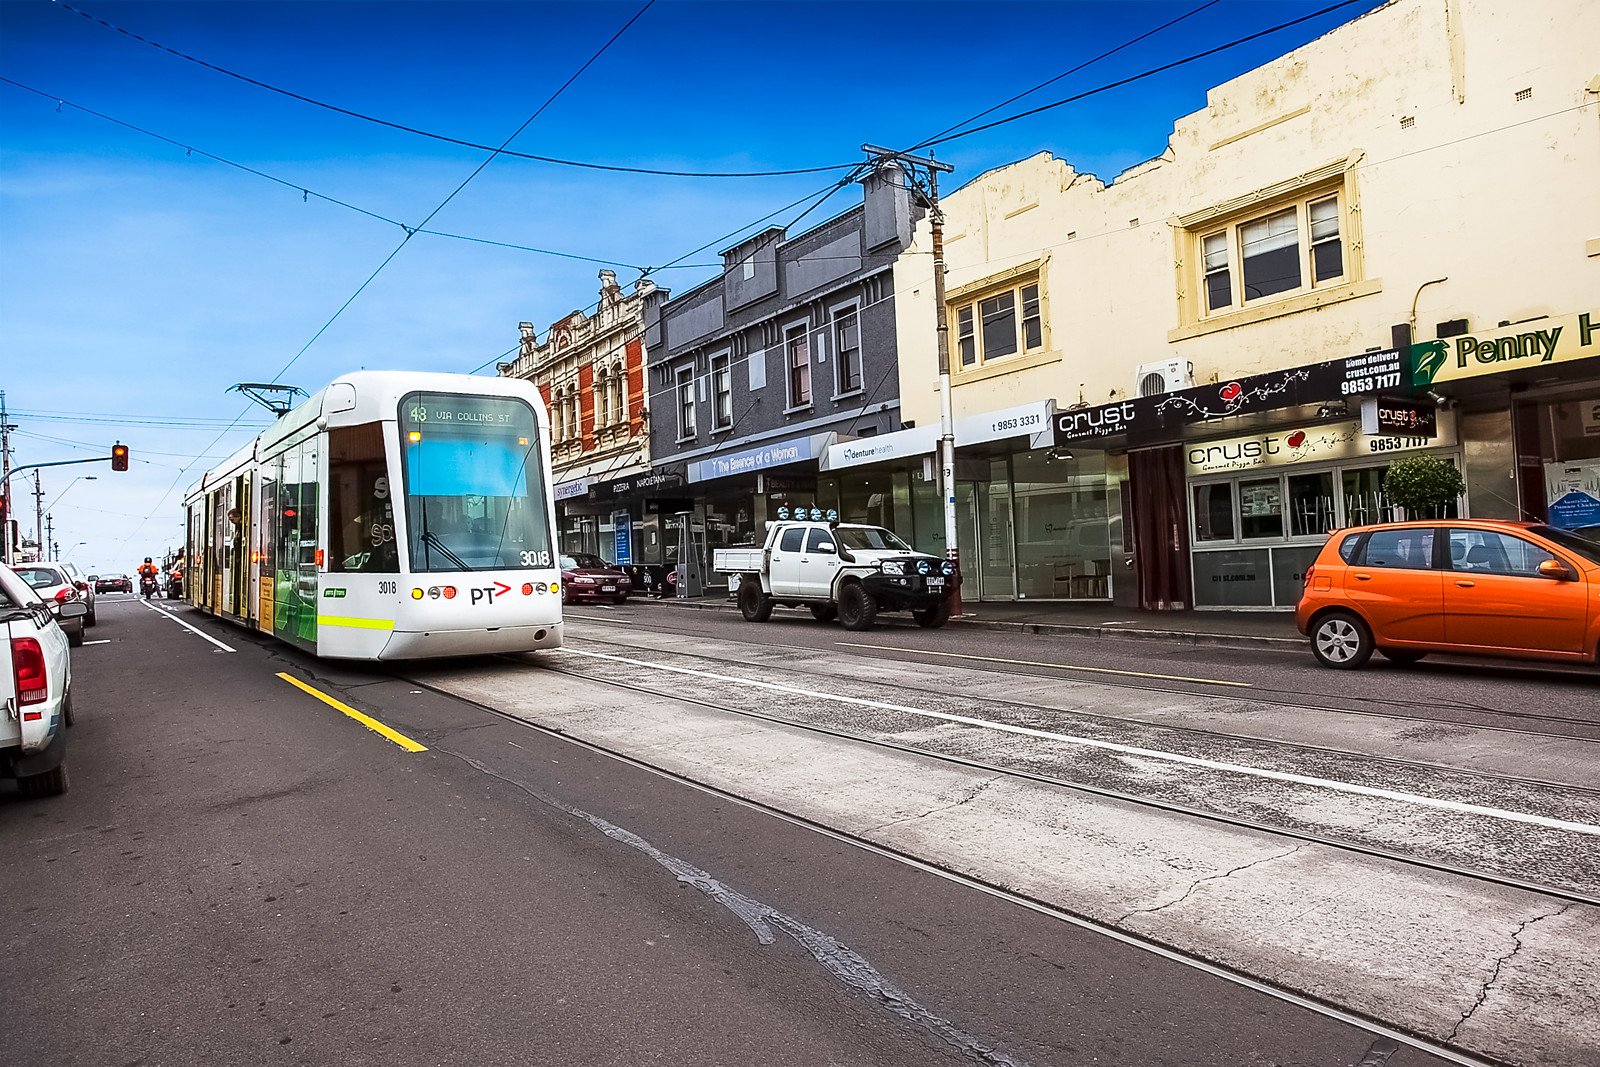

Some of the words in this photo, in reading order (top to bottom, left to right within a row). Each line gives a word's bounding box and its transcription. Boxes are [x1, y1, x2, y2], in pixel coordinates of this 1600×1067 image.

[1456, 326, 1563, 368] Penny
[1367, 351, 1400, 364] delivery
[1345, 362, 1400, 379] crust.com.au
[1341, 377, 1374, 395] 9853
[1375, 372, 1401, 389] 7177
[410, 406, 427, 422] 43
[436, 411, 452, 420] VIA
[457, 412, 494, 422] COLLINS
[997, 418, 1018, 431] 9853
[1019, 413, 1040, 427] 3331
[1059, 402, 1135, 431] crust
[1378, 408, 1409, 421] crust
[1188, 437, 1279, 464] crust
[1370, 438, 1402, 452] 9853
[718, 460, 730, 473] The
[771, 446, 799, 462] Woman
[520, 550, 550, 566] 3018
[379, 581, 397, 594] 3018
